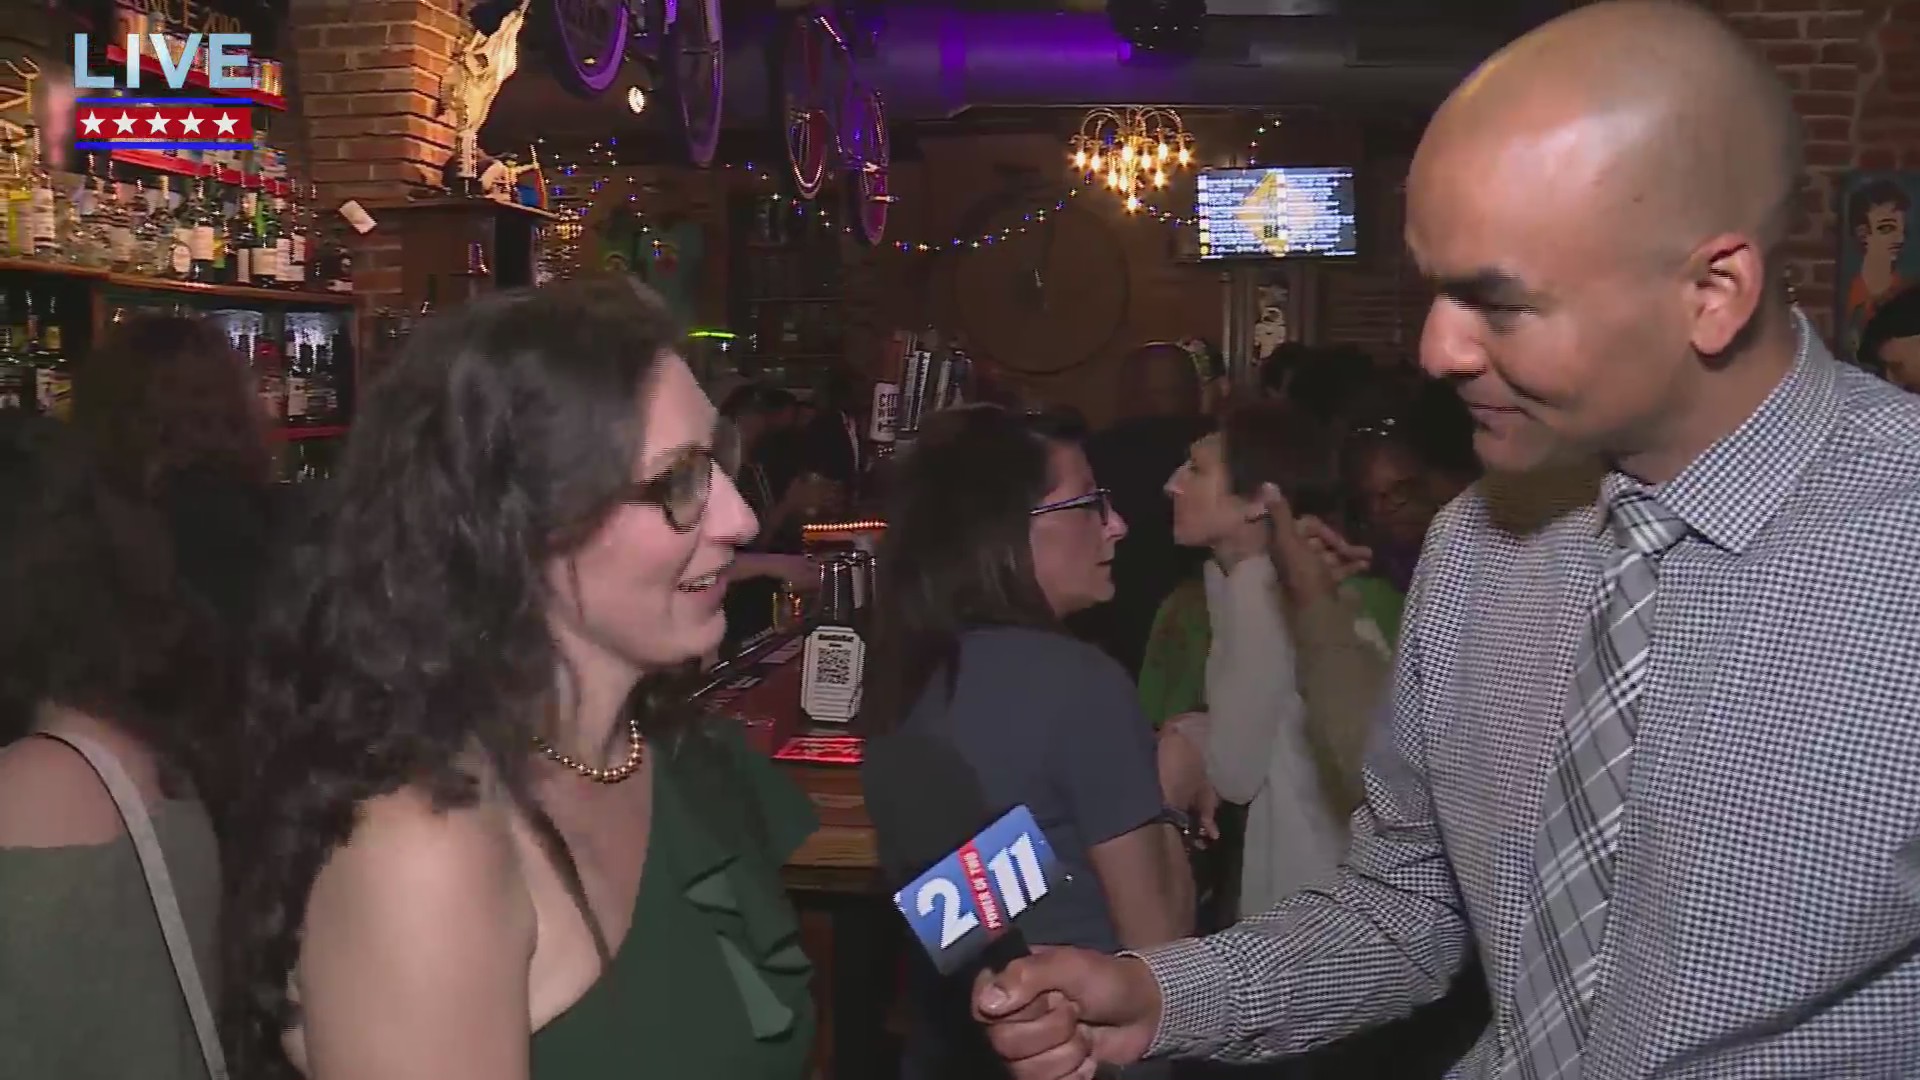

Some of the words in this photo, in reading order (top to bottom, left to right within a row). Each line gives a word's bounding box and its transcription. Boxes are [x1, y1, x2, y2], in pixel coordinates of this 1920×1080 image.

[963, 851, 981, 878] TWO
[987, 832, 1049, 919] 11
[916, 877, 979, 950] 2
[977, 892, 1002, 929] POWER
